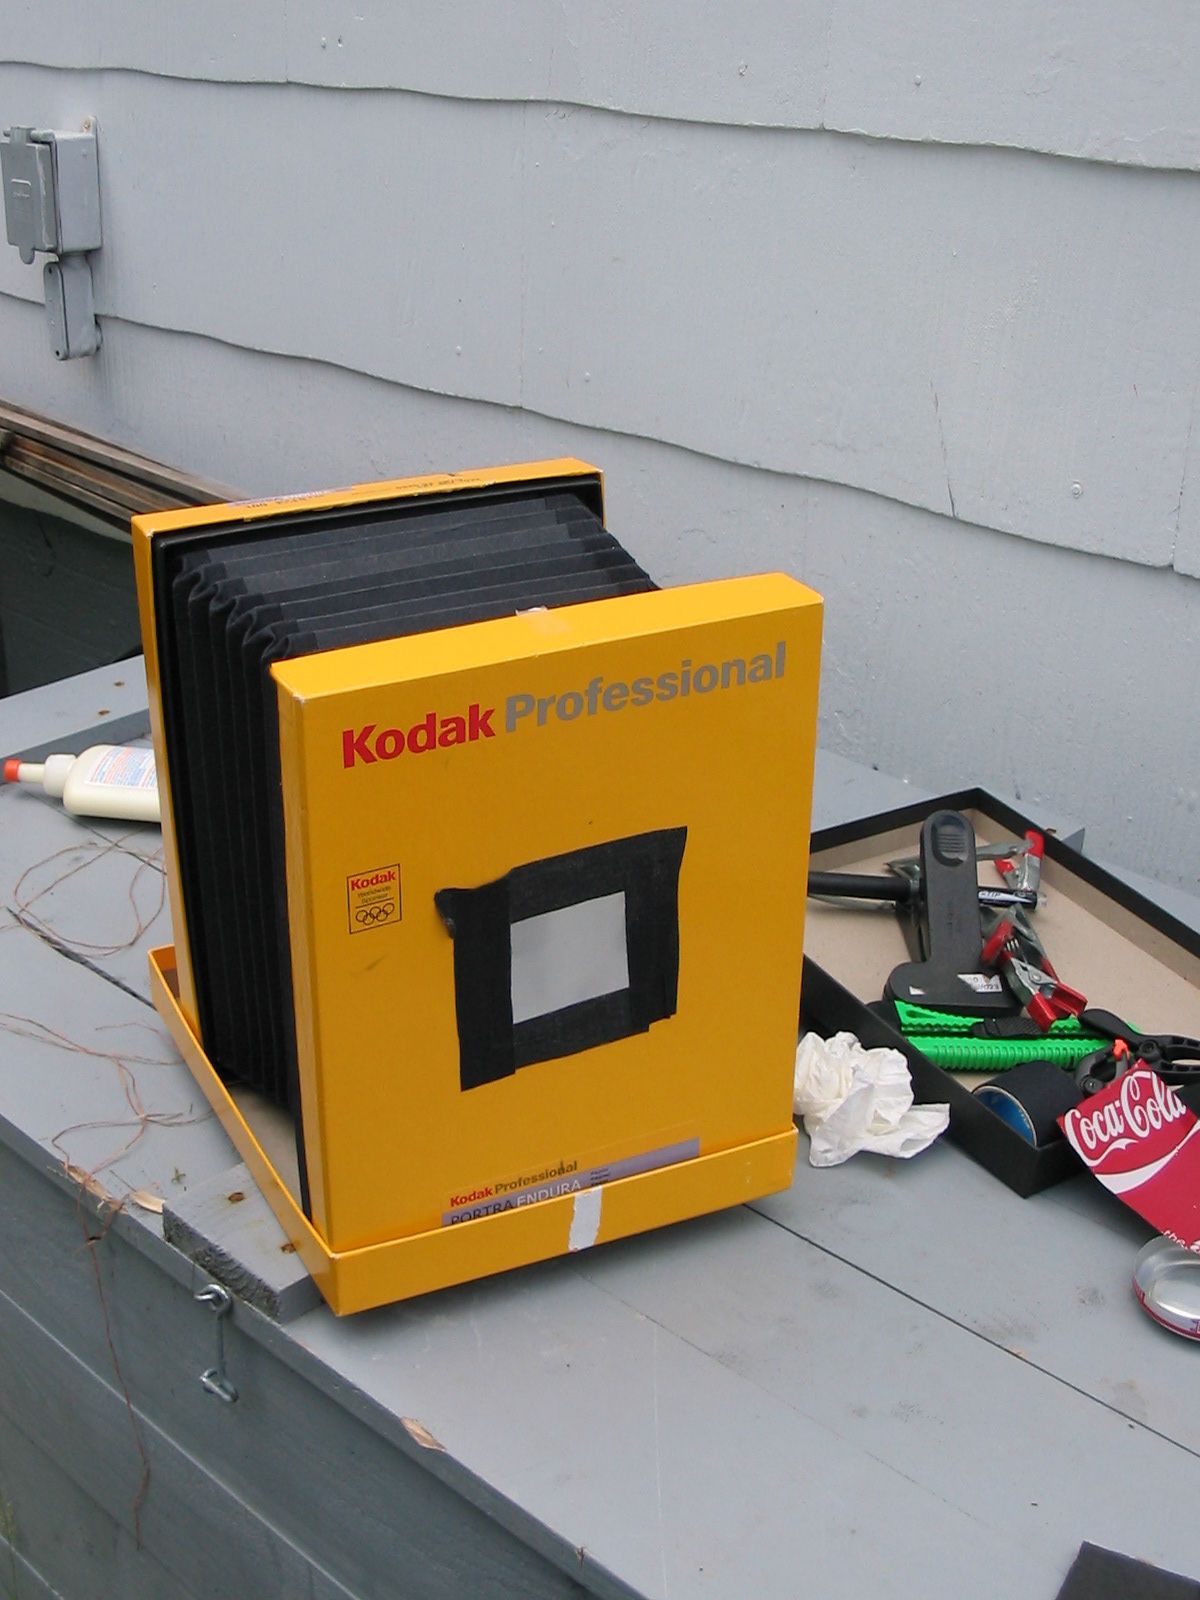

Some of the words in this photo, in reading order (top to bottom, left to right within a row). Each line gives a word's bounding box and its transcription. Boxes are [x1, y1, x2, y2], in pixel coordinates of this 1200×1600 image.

[342, 703, 496, 769] Kodak
[505, 641, 787, 733] Professional
[351, 871, 396, 891] Kodak
[450, 1186, 493, 1208] Kodak
[495, 1160, 578, 1195] Professional
[450, 1199, 515, 1226] PORTRA
[516, 1180, 582, 1208] ENDURA
